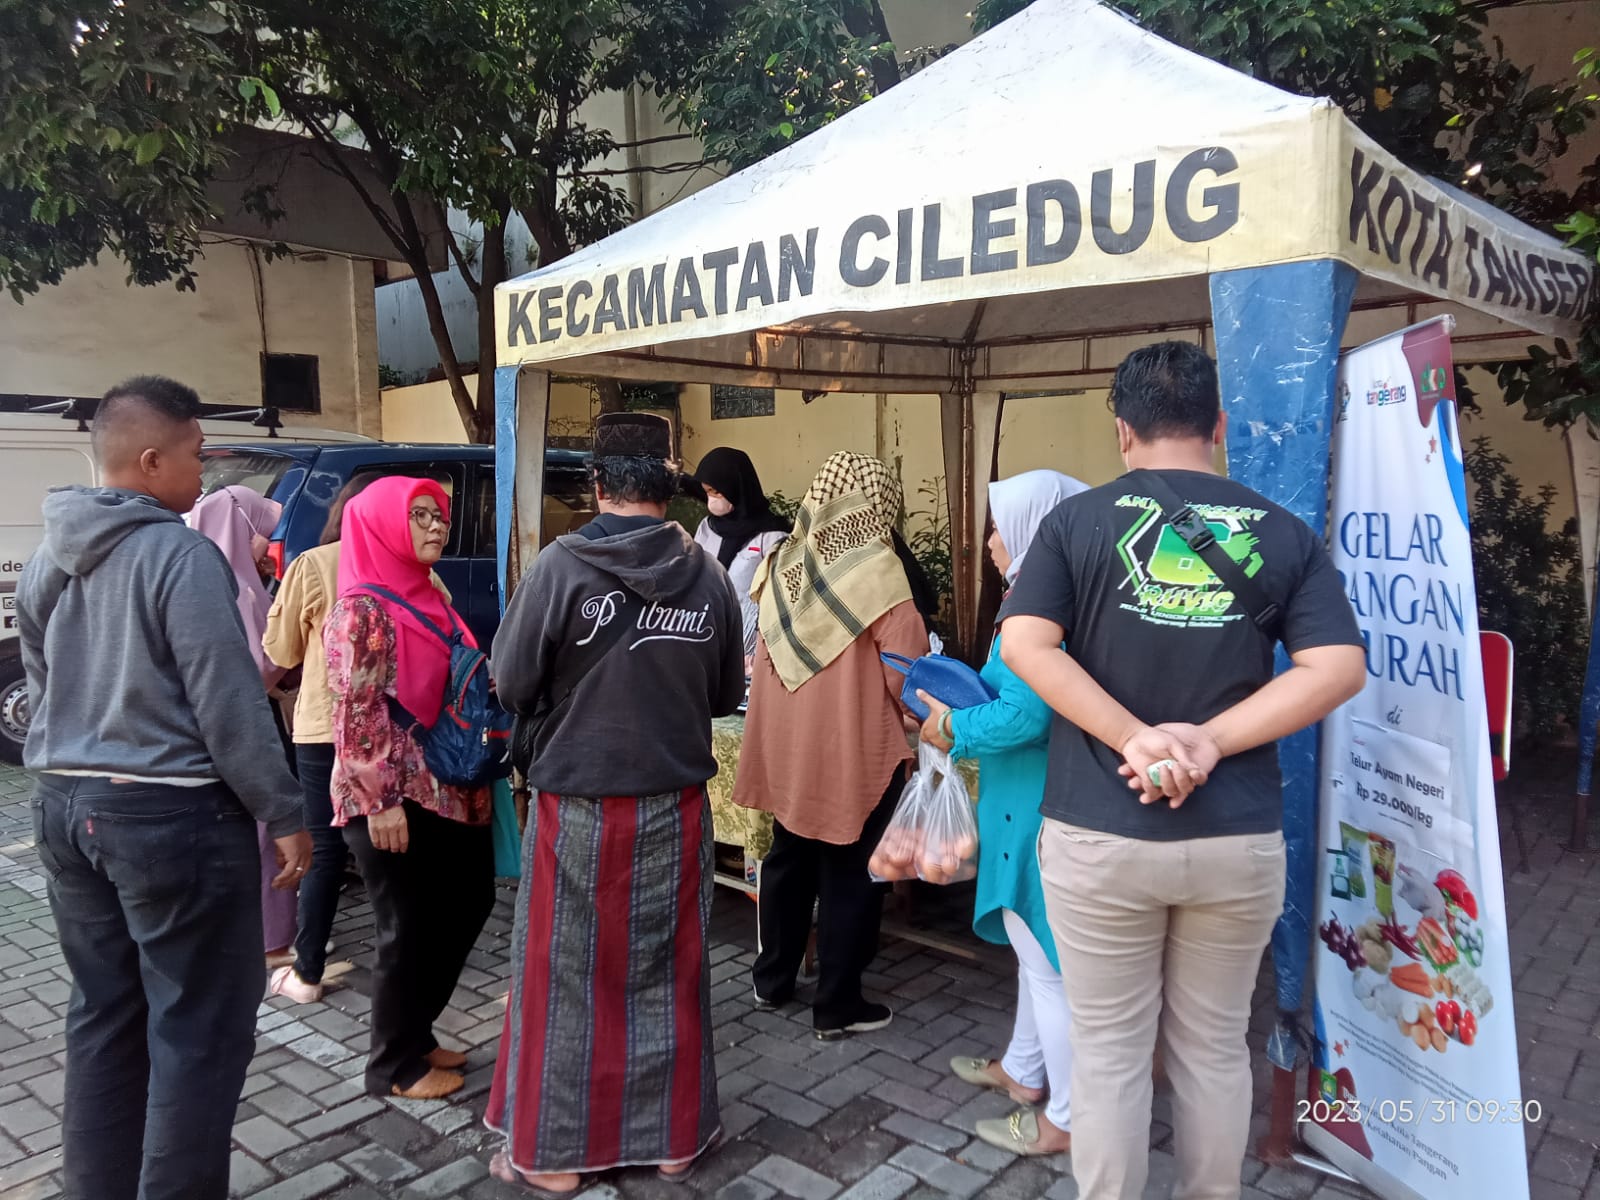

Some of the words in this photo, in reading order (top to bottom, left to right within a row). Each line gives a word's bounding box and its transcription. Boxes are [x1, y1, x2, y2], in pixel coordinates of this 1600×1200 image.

[507, 227, 819, 347] KECAMATAN
[838, 147, 1241, 288] CILEDUG
[1350, 147, 1452, 291] KOTA
[1464, 223, 1590, 322] TANGER
[1340, 511, 1448, 567] GELAR
[1360, 629, 1465, 701] URAH
[1386, 705, 1403, 725] di
[1350, 752, 1372, 772] Telur
[1375, 762, 1403, 785] Ayam
[1406, 774, 1445, 800] Negeri
[1356, 781, 1370, 801] Rp
[1372, 790, 1433, 828] 29.000/kg
